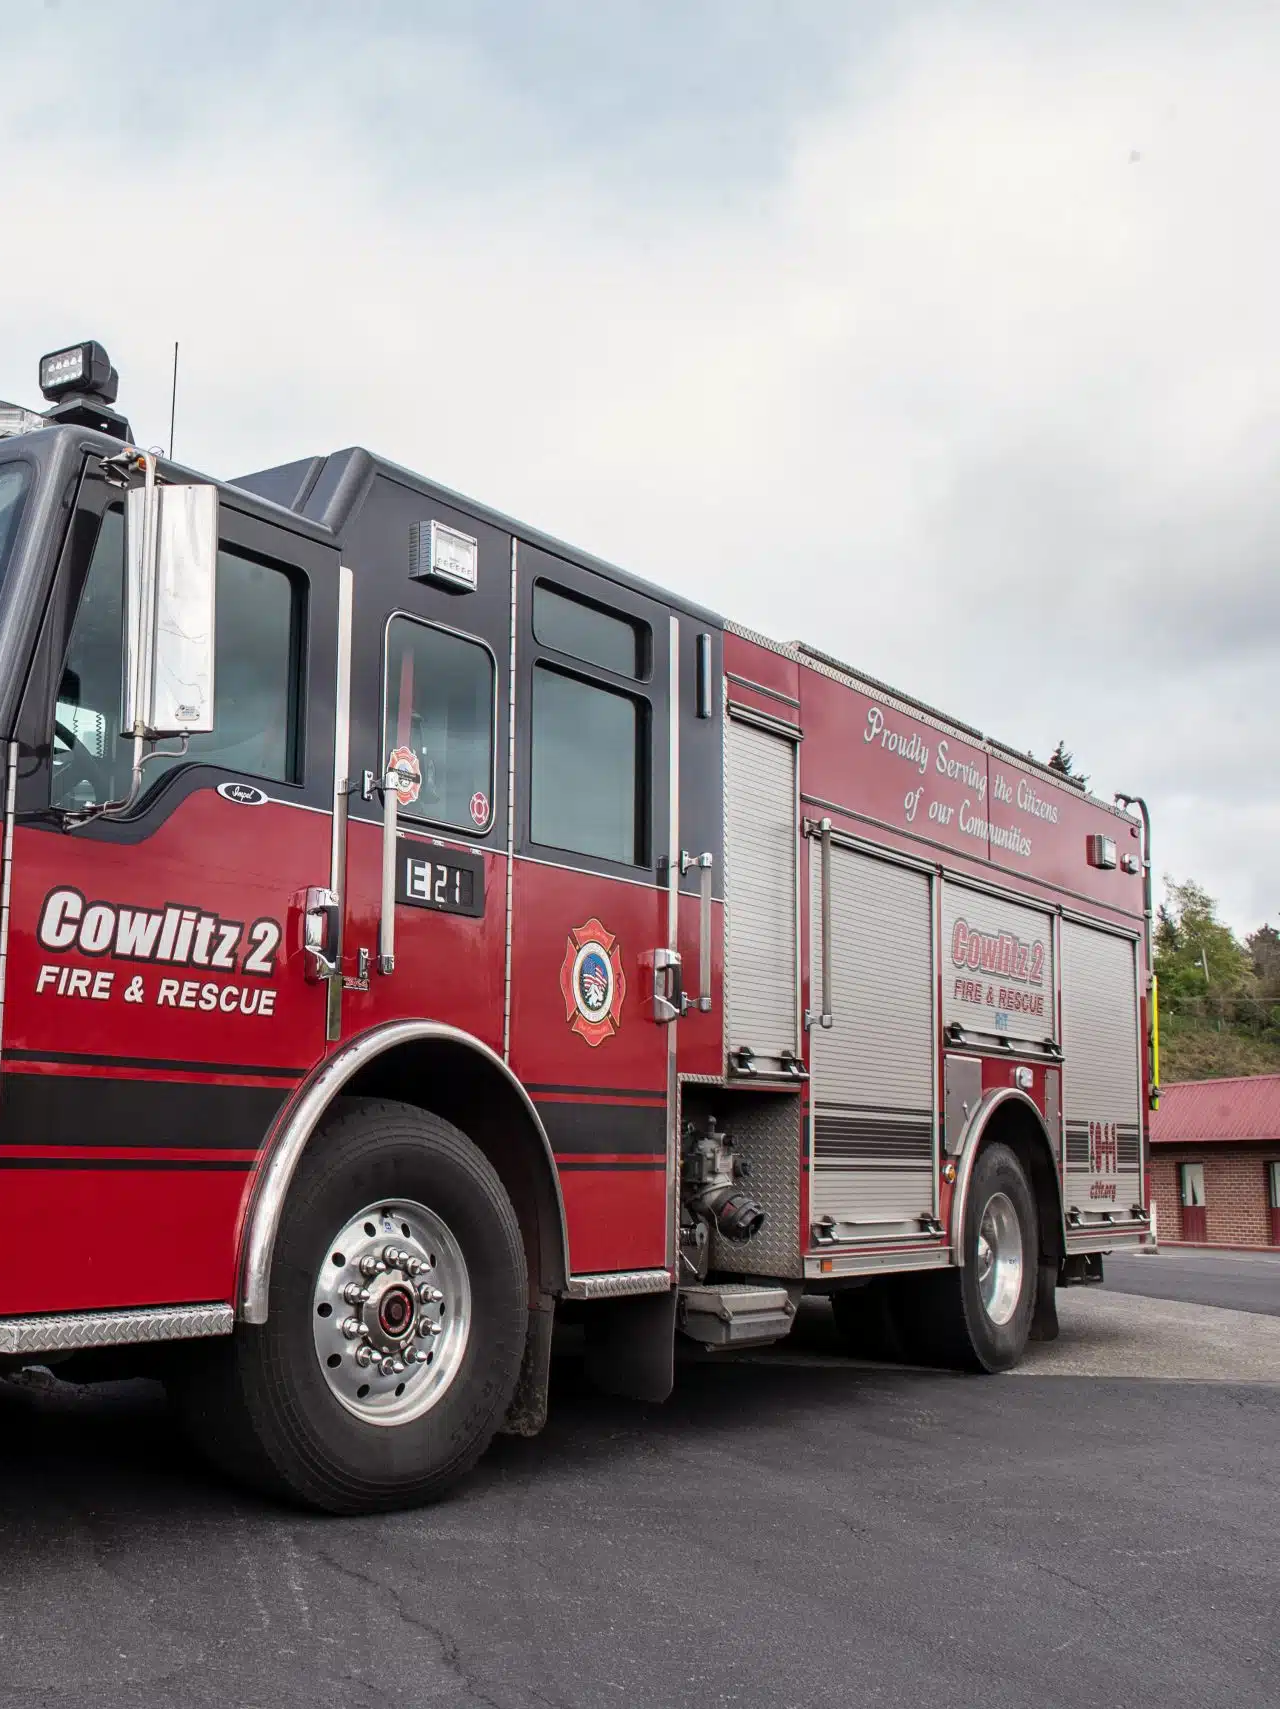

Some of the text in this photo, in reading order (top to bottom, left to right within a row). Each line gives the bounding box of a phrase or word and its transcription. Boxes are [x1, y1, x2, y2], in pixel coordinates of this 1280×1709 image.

[864, 706, 1058, 823] Proudly Serving the Citizens
[904, 786, 1031, 856] of our Communities
[38, 887, 281, 975] Cowlitz 2
[952, 919, 1044, 985] Cowlitz 2
[36, 964, 276, 1016] FIRE & RESCUE
[954, 978, 1044, 1016] FIRE & RESCUE
